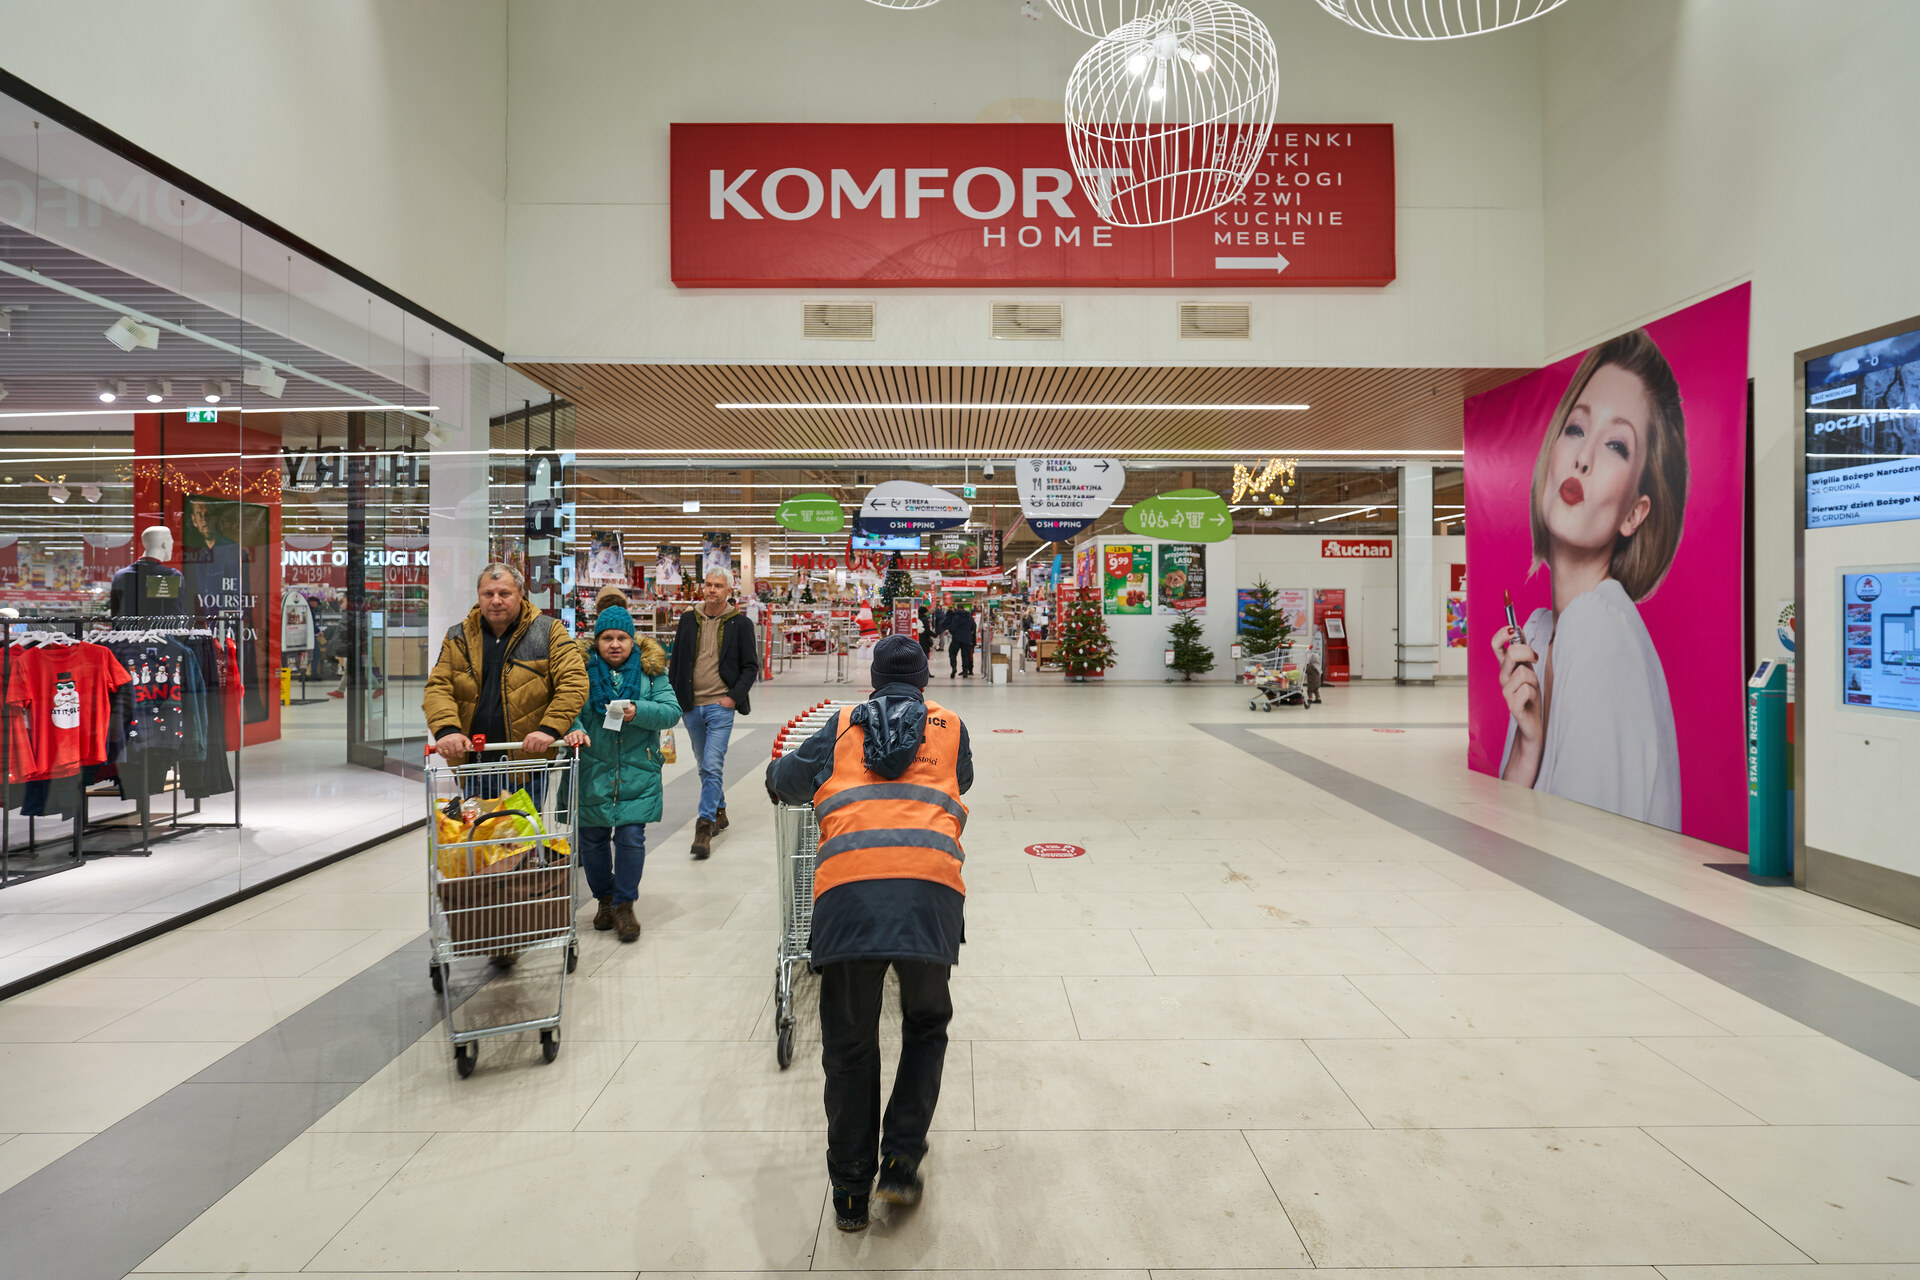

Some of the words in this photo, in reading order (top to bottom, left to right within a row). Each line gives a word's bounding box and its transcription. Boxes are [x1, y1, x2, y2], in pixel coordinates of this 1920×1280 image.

[1214, 152, 1309, 167] PŁTKI
[709, 166, 1132, 221] KOMFORT
[1214, 192, 1301, 206] DRZWI
[1214, 211, 1343, 226] KUCHNIE
[982, 225, 1113, 248] HOME
[1214, 231, 1306, 245] MEBLE
[1814, 405, 1902, 435] POCZĄTEK
[1842, 472, 1875, 482] Bożego
[1822, 482, 1861, 494] GRUDNIA
[1811, 504, 1849, 513] Pierwszy
[1876, 496, 1911, 507] Bożego
[1822, 511, 1860, 522] GRUDNIA
[1324, 540, 1390, 558] Auchan
[280, 550, 325, 566] UNKT
[792, 551, 838, 571] Miło
[896, 552, 971, 571] widzieć
[222, 577, 238, 591] BE
[197, 593, 258, 608] YOURSELF
[928, 717, 947, 729] ICE
